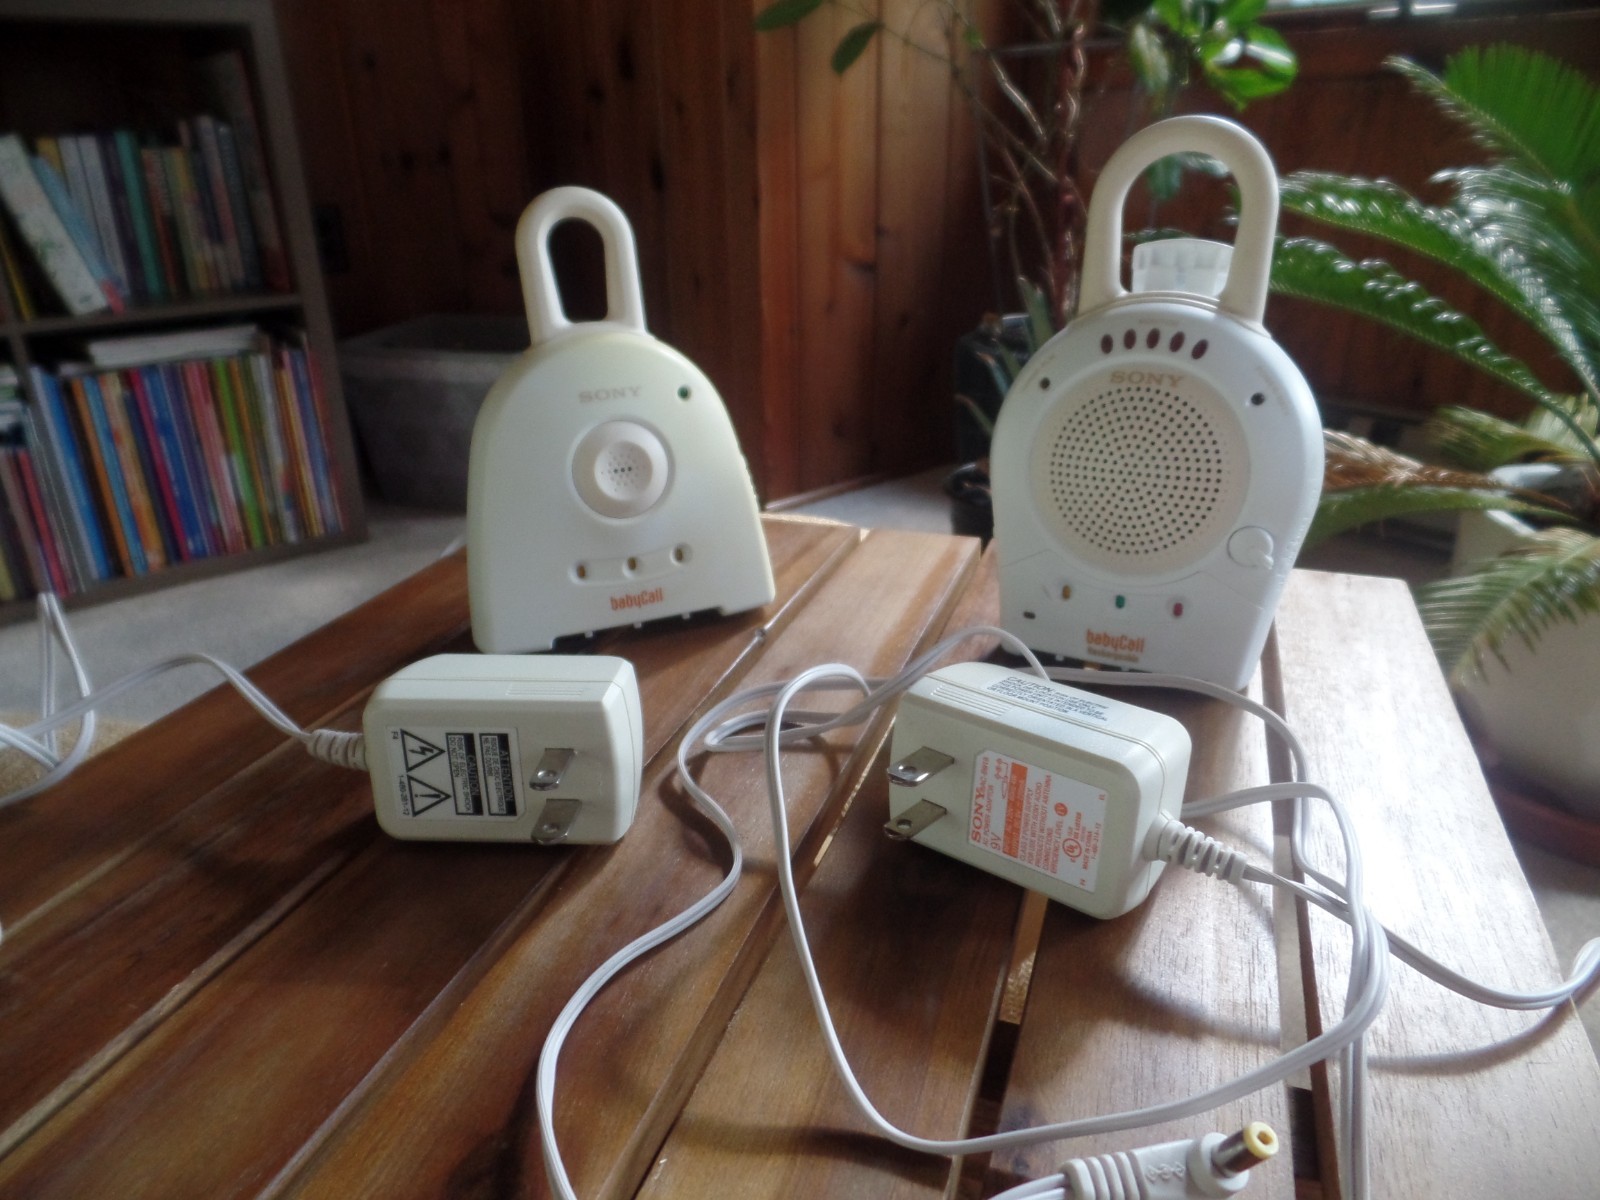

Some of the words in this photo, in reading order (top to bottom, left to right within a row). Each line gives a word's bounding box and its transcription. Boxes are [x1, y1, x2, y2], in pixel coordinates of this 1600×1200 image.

[1110, 370, 1185, 388] SONY
[578, 386, 642, 402] SONY
[610, 587, 664, 611] babyCall
[1086, 629, 1144, 653] babyCall
[467, 755, 479, 795] CAUTION
[500, 751, 513, 801] ATTENTION
[971, 787, 985, 843] SONY
[990, 832, 1002, 851] 9V
